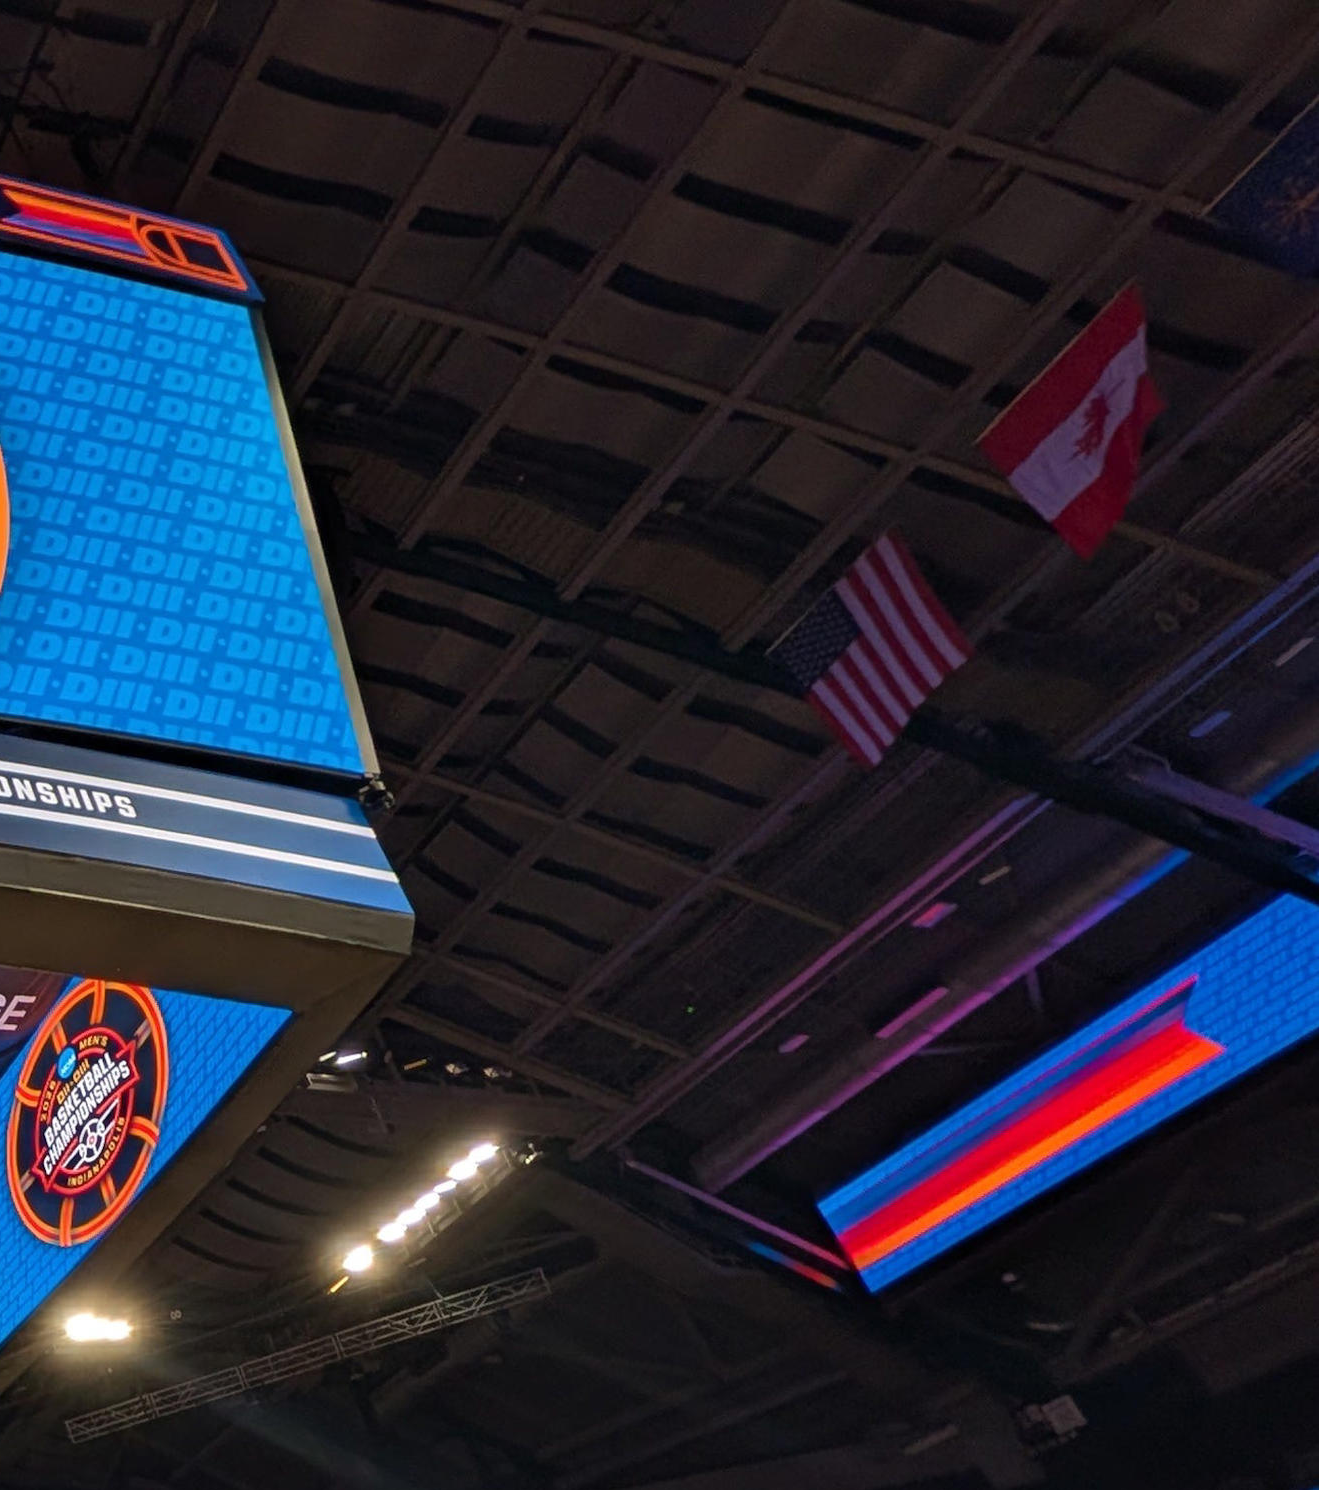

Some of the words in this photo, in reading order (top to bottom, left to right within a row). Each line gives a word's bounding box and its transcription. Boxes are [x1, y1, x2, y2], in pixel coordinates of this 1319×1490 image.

[43, 1060, 131, 1176] CHAMPIONSHIPS
[44, 1052, 116, 1146] BASKETBALL
[67, 1116, 125, 1186] INDIANAPOLIS
